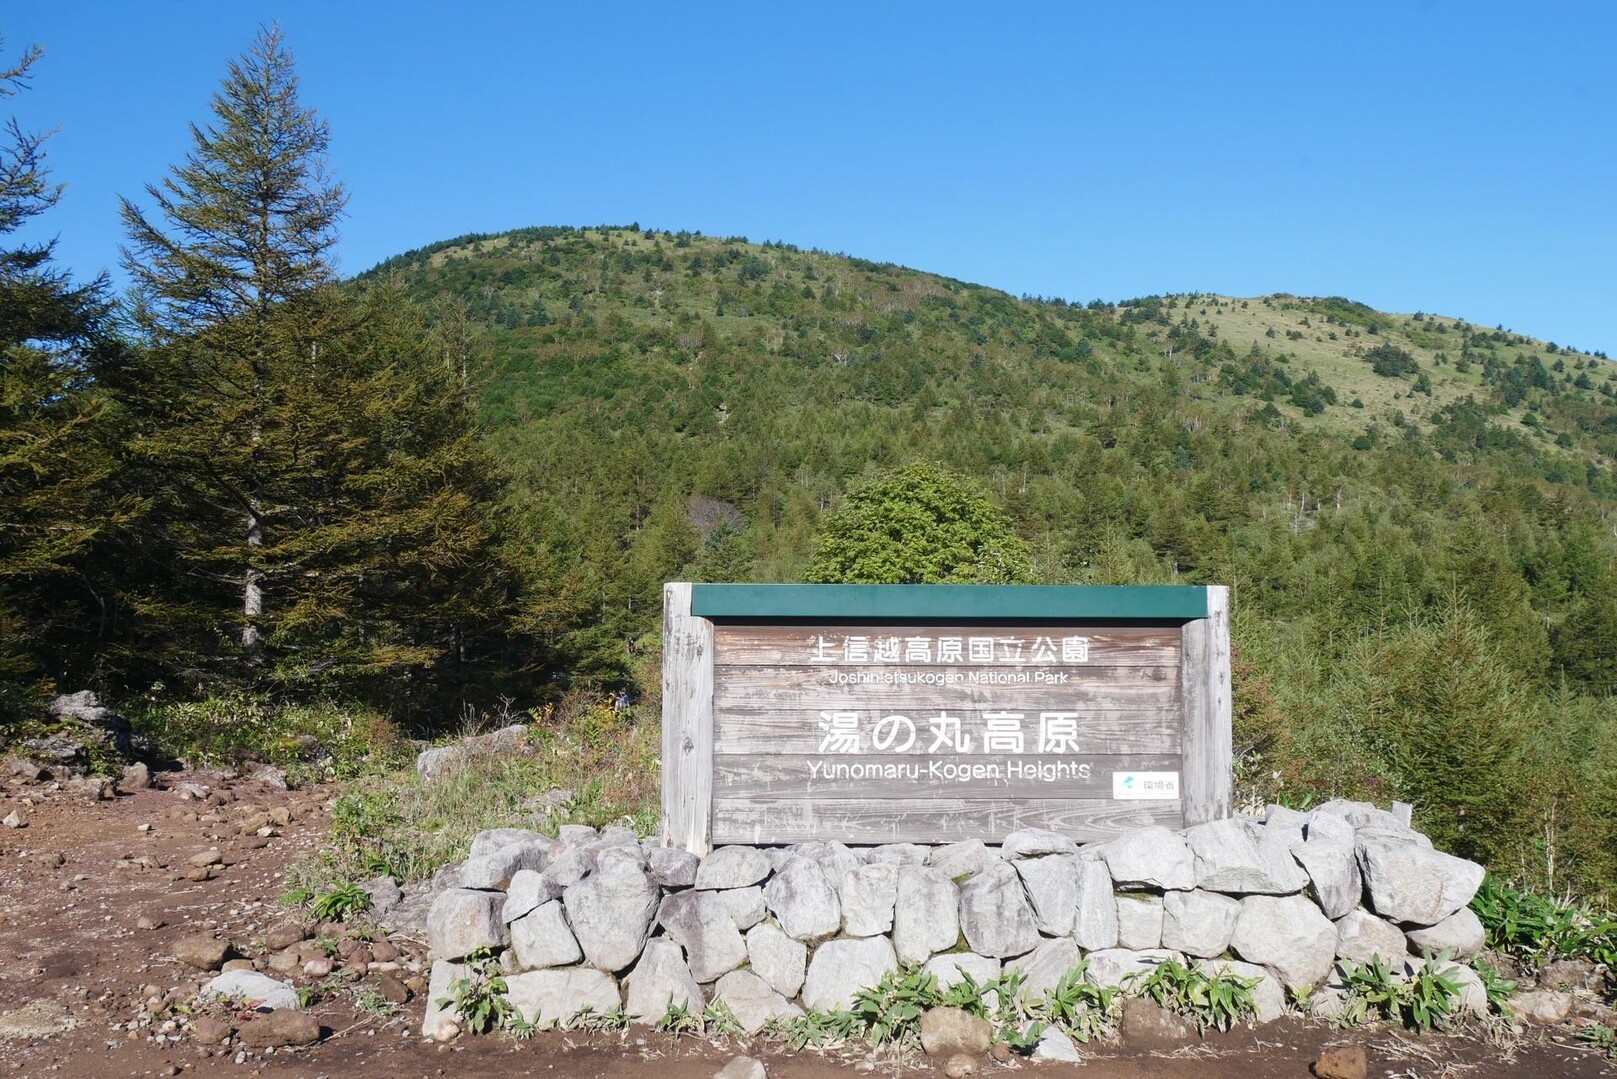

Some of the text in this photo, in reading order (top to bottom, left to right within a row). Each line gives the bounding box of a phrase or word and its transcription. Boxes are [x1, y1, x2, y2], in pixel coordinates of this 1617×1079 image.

[808, 636, 1090, 663] 上信越高原国立公園
[968, 671, 1030, 684] National
[1034, 671, 1069, 684] Park
[818, 711, 1080, 754] 湯の丸高原
[806, 760, 1091, 782] Yunomaru-Kogen Heights
